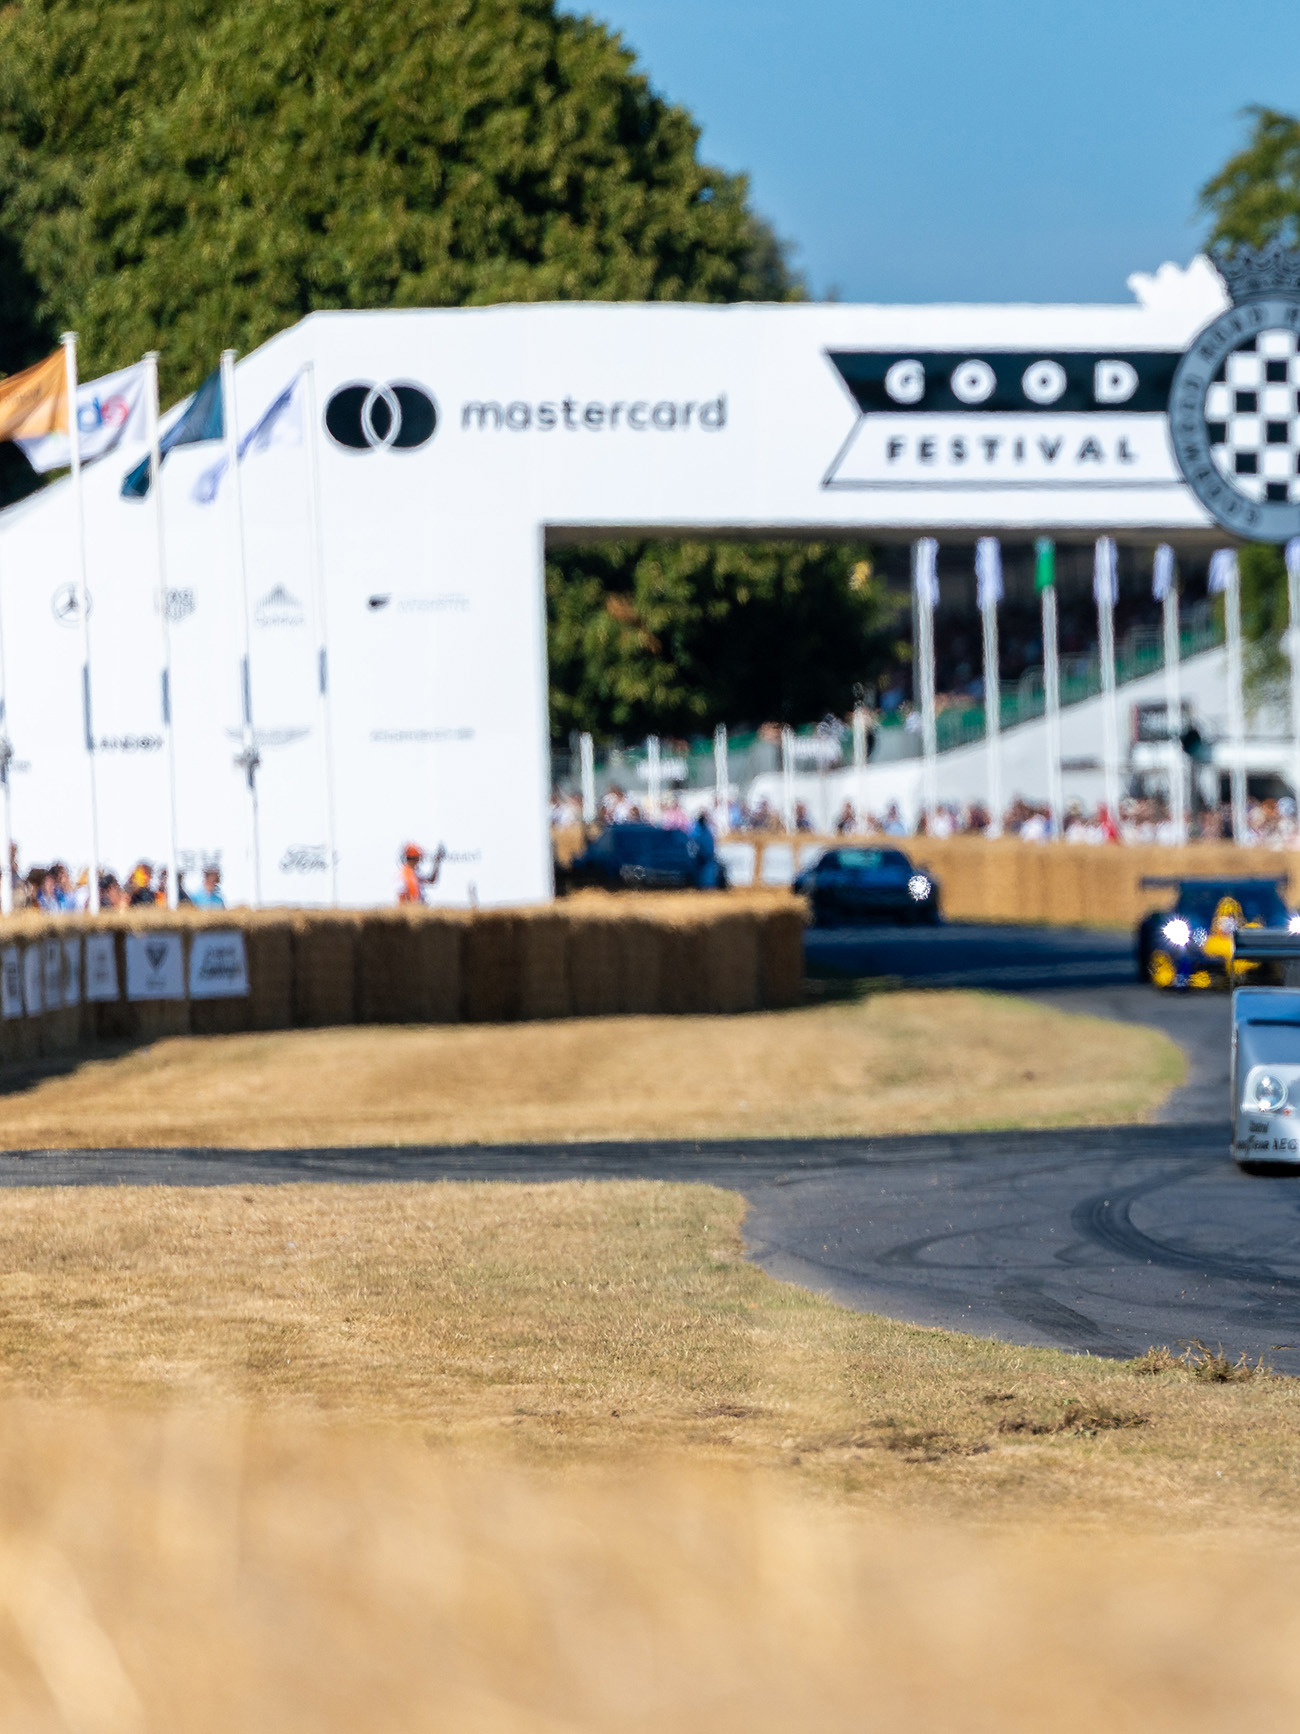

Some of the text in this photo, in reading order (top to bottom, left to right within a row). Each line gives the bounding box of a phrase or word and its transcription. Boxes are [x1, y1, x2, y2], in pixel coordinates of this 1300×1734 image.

[885, 359, 1139, 404] GOOD
[460, 391, 727, 431] mastercard
[887, 434, 1137, 465] FESTIVAL
